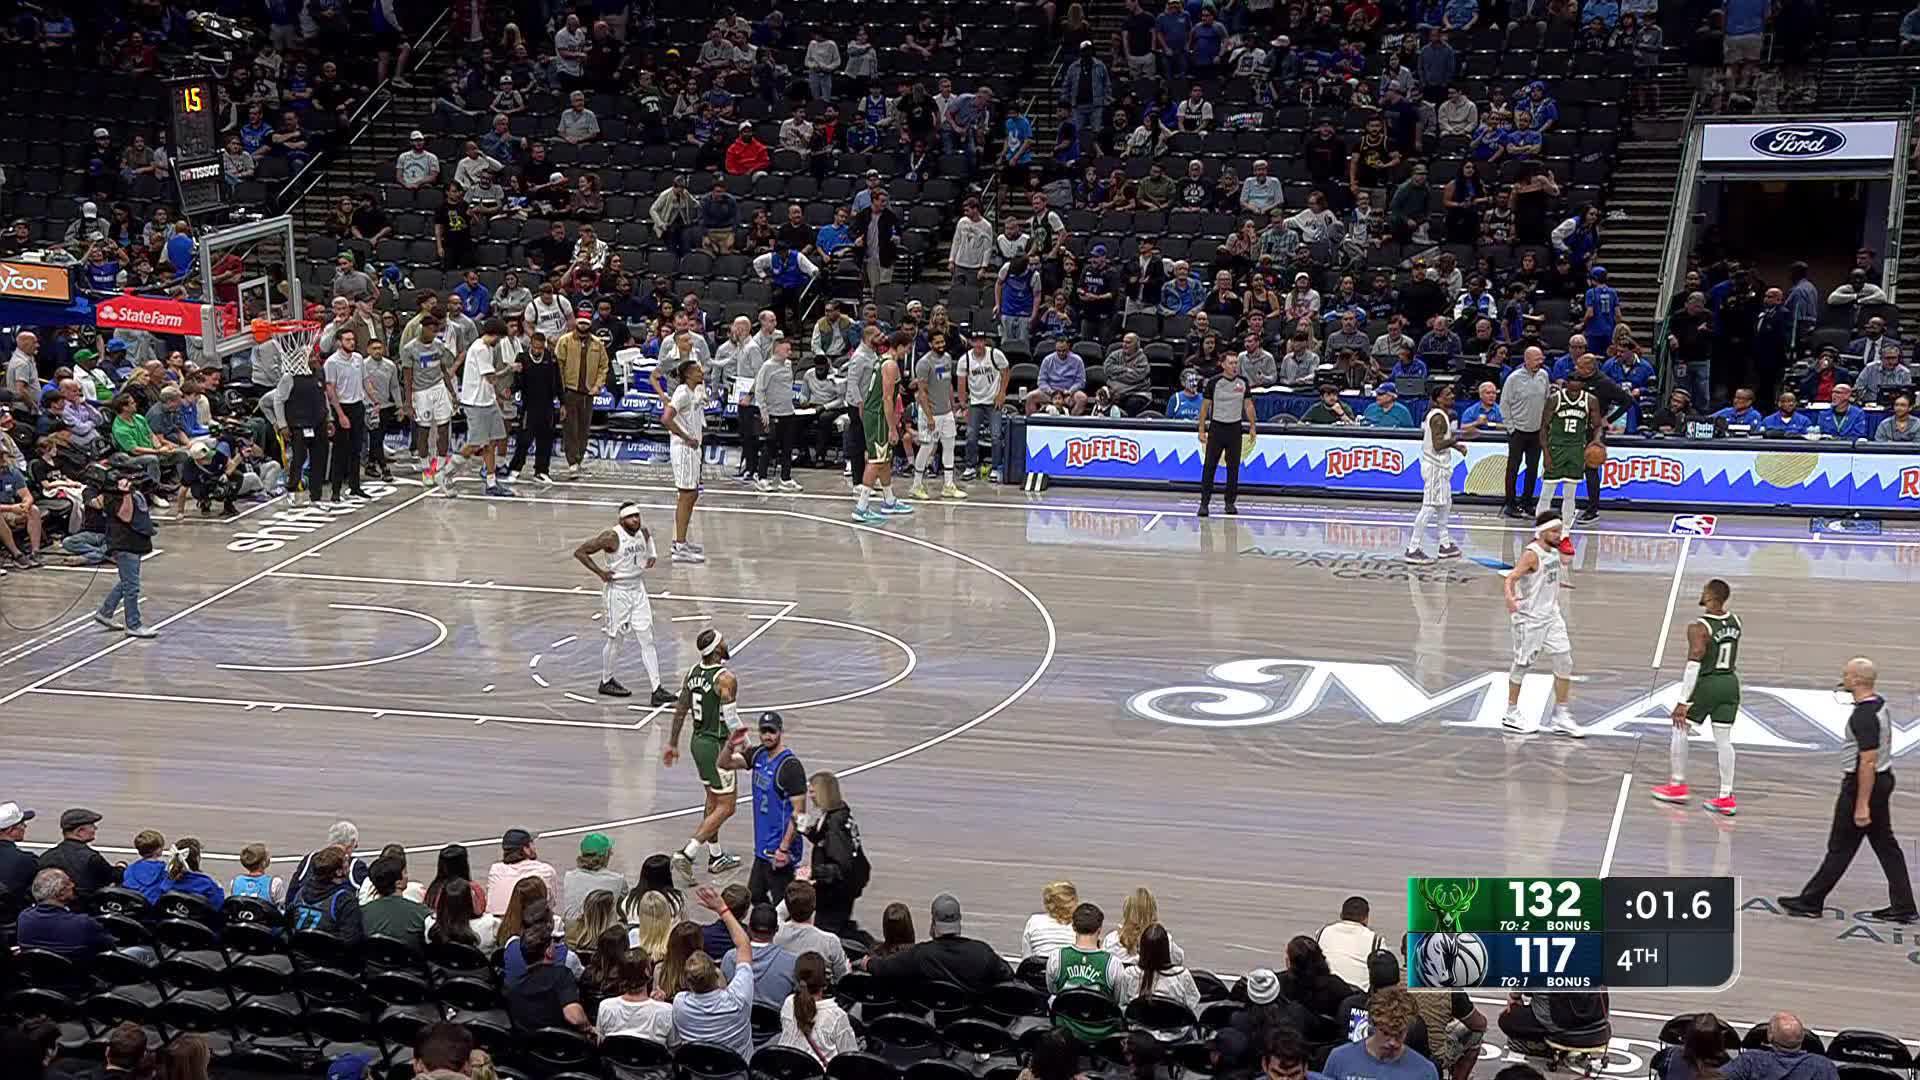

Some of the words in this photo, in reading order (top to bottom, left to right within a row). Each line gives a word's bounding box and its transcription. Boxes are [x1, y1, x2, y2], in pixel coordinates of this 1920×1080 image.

[184, 87, 201, 112] 15
[1769, 130, 1824, 152] Ford
[190, 164, 220, 179] TISSOT
[593, 396, 612, 406] TSW
[622, 398, 648, 408] UTSW
[1564, 418, 1577, 432] 12
[584, 439, 622, 459] SW
[1067, 438, 1139, 465] RUFFLES
[1326, 448, 1402, 476] RUFFLES
[1602, 458, 1682, 486] RUFFLES
[1715, 642, 1732, 669] 0
[692, 692, 703, 721] 5
[760, 795, 769, 815] 2
[295, 907, 322, 929] 77
